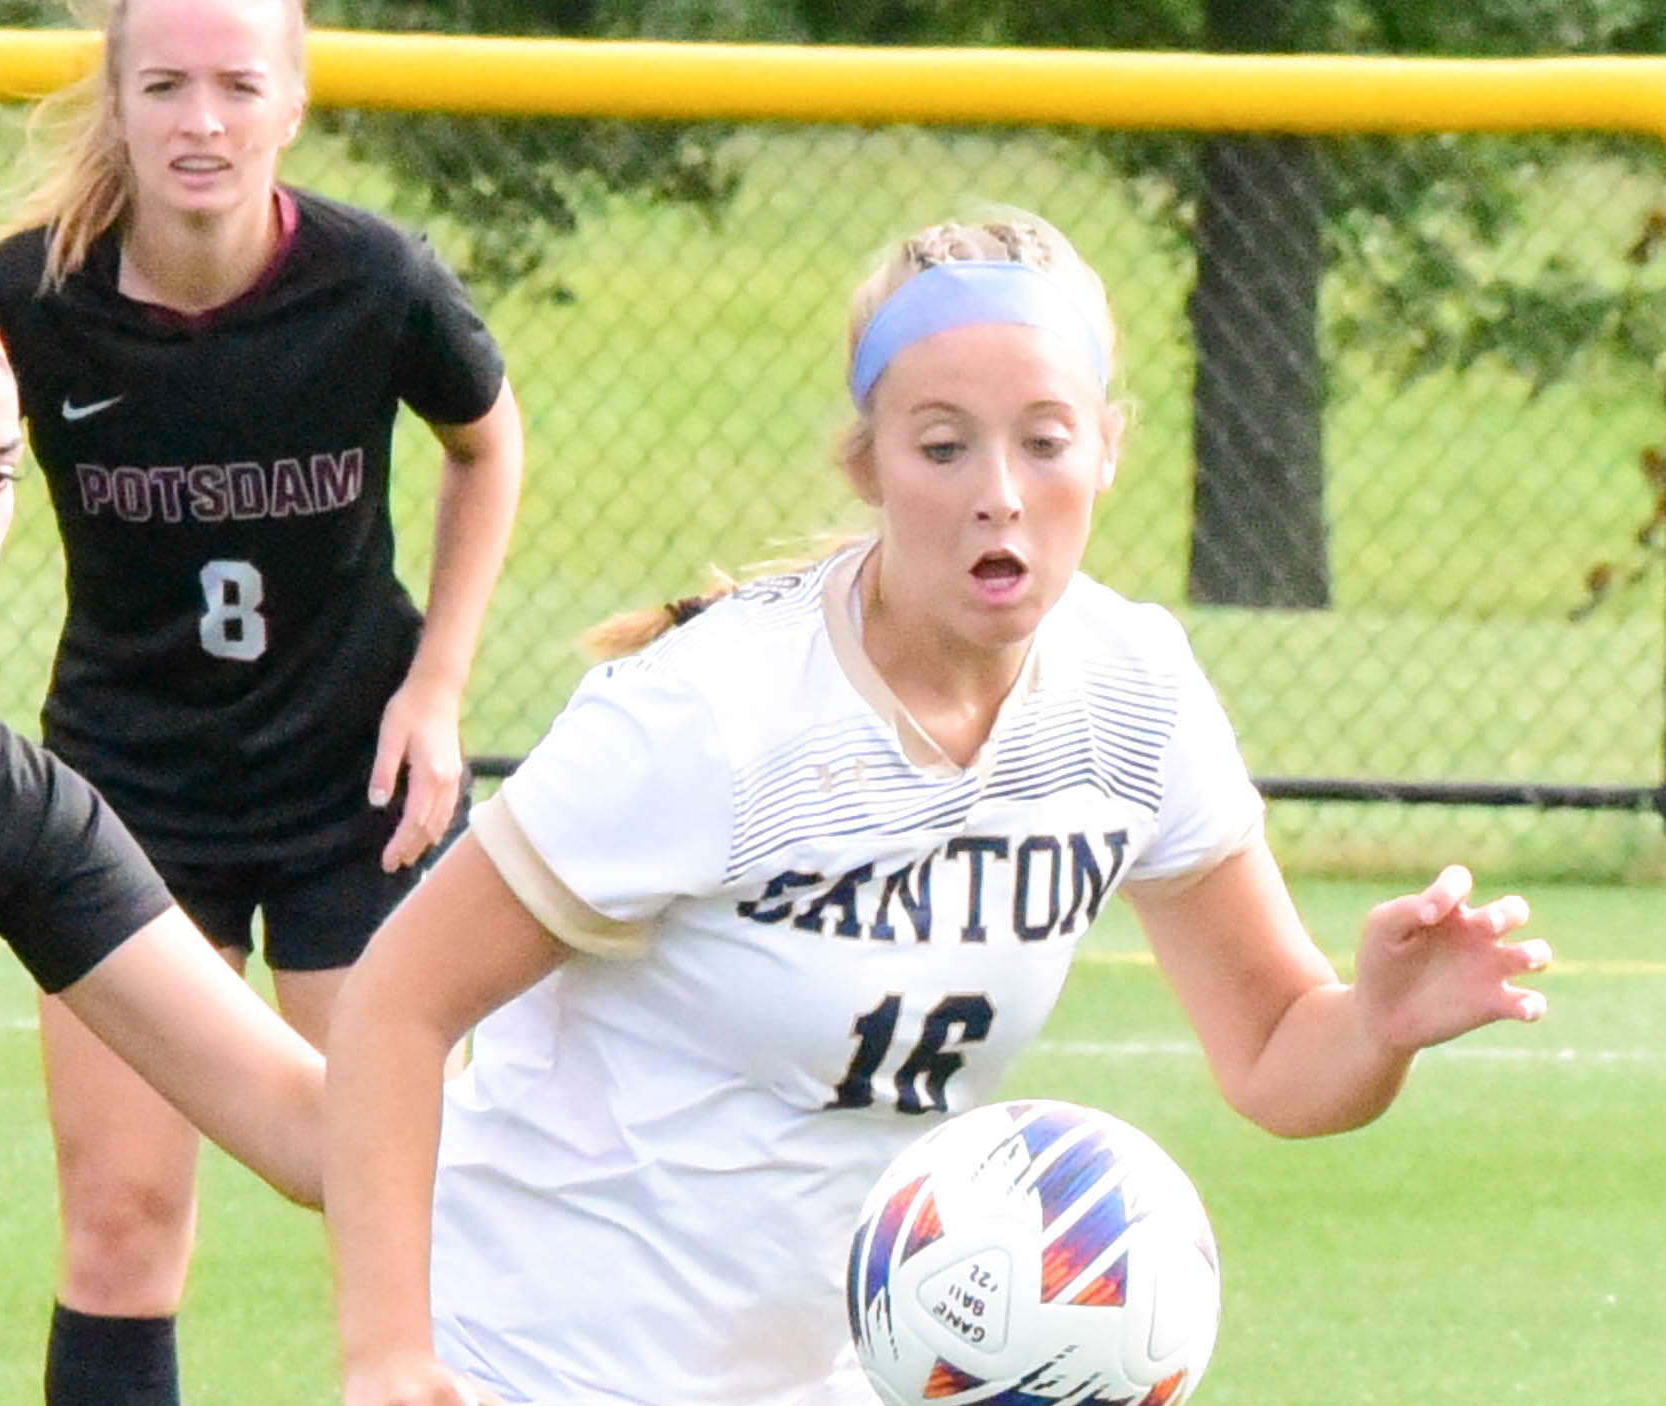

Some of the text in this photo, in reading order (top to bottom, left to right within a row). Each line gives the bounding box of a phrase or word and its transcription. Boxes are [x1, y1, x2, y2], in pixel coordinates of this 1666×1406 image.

[76, 446, 363, 523] POTSDAM
[199, 560, 267, 663] 8
[735, 831, 1129, 943] CANTON
[833, 991, 997, 1114] 16
